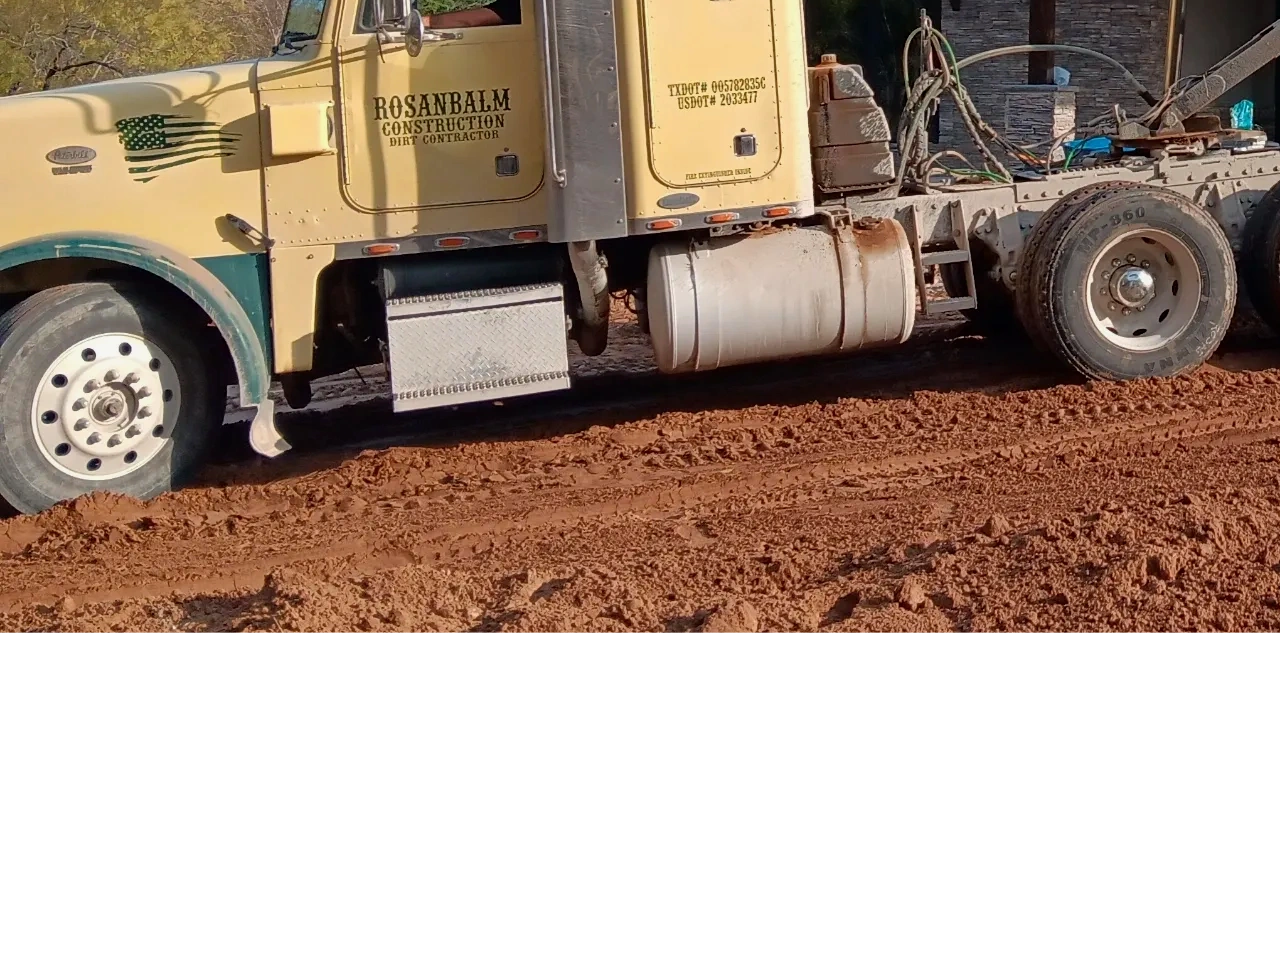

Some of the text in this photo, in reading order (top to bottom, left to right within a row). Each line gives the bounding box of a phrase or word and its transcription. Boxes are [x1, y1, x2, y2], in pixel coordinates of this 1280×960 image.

[667, 76, 766, 97] TXDOT# 005782835C
[373, 88, 512, 121] ROSANBALM
[677, 90, 758, 110] USDOT# 2033477
[381, 113, 505, 137] CONSTRUCTION
[389, 129, 500, 147] DIRT CONTRACTOR
